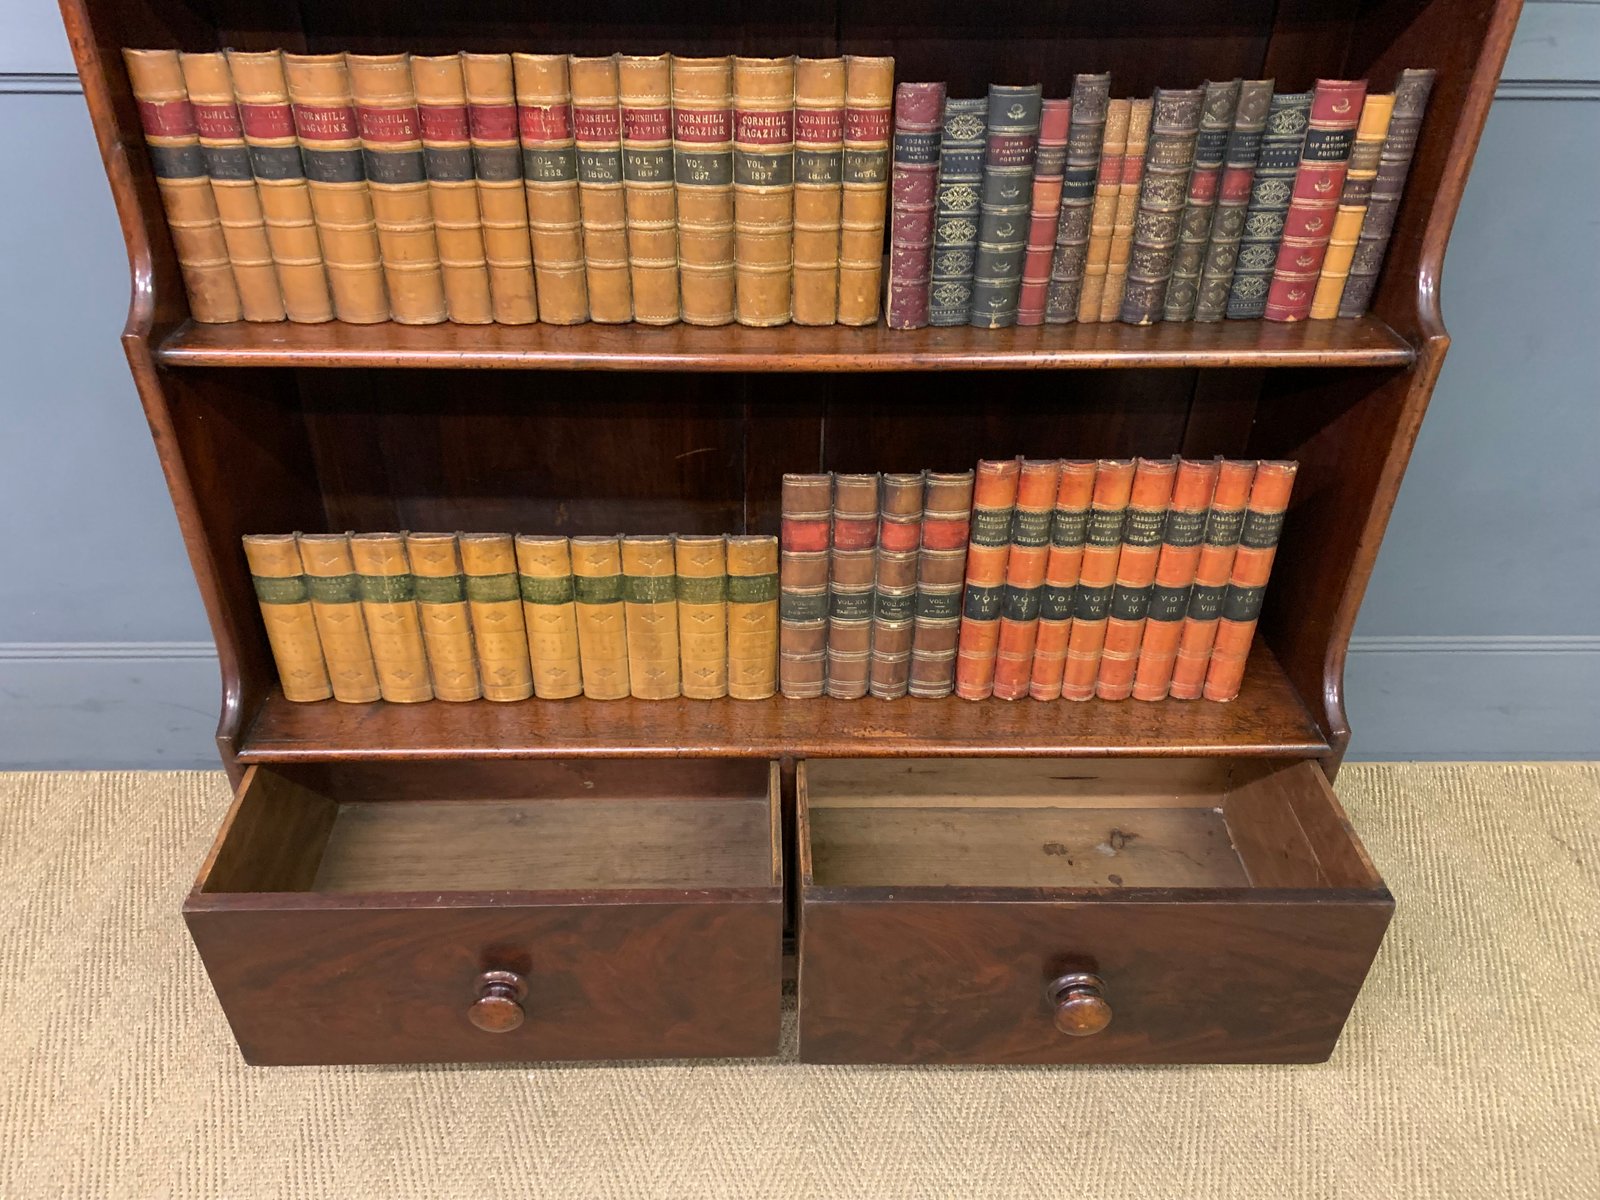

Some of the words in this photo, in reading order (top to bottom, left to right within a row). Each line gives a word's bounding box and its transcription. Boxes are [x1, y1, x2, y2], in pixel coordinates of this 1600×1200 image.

[300, 111, 346, 121] CORNHILL
[576, 114, 617, 124] CORNHILL
[625, 114, 664, 122] CORNHILL
[680, 114, 724, 124] CORNHILL
[743, 116, 786, 126] CORNHILL
[798, 115, 840, 125] CORNHILL
[1084, 594, 1108, 602] VOL
[1122, 594, 1146, 602] VOL
